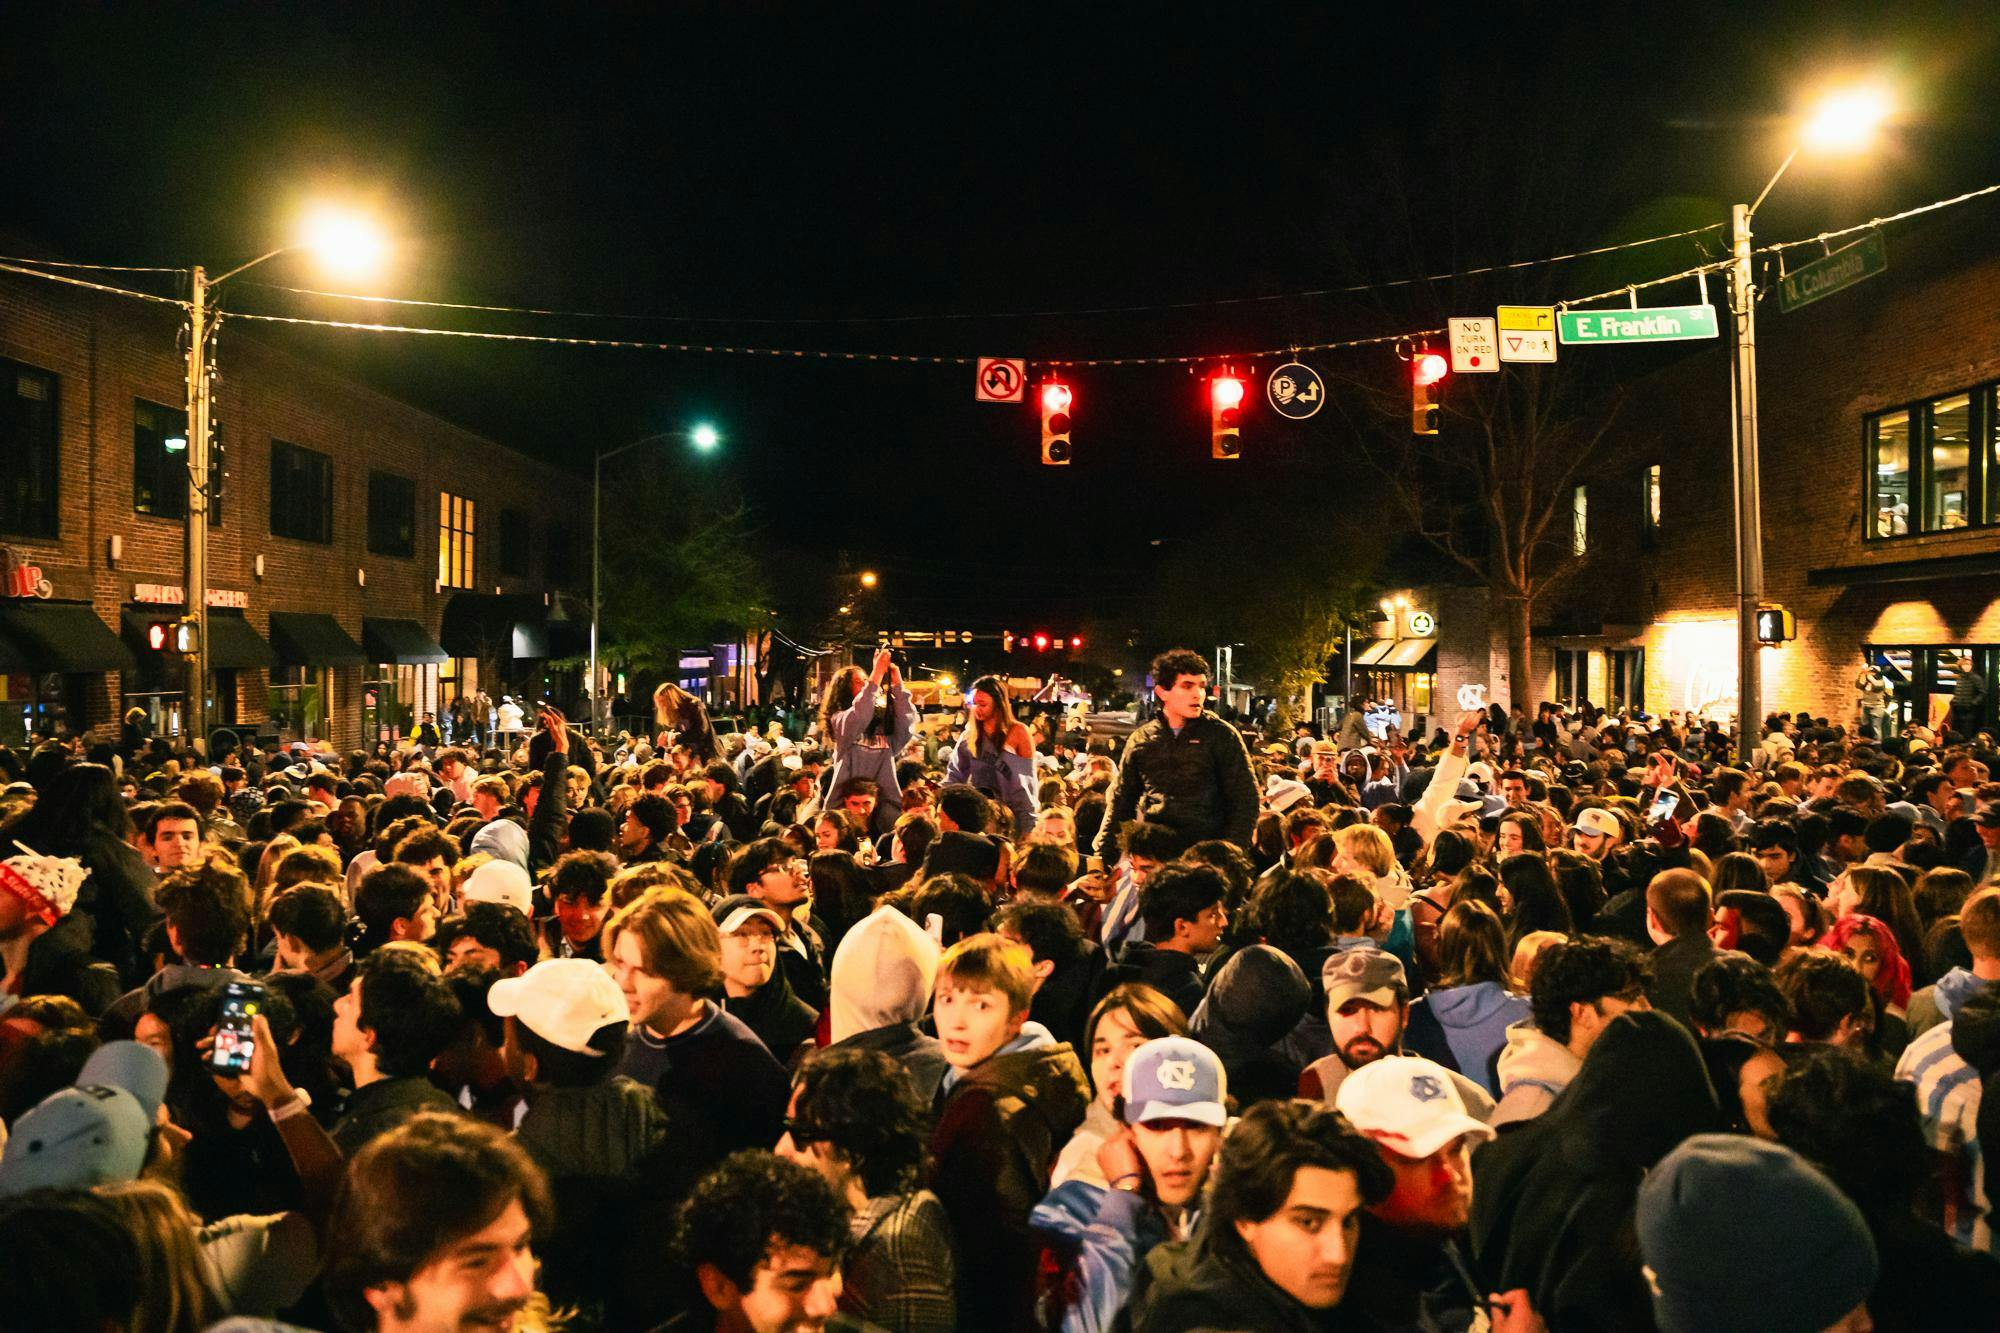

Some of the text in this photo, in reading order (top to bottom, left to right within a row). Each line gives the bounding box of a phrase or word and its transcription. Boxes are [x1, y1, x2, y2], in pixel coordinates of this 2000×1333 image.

[1802, 253, 1864, 295] Columbia
[1463, 322, 1481, 332] NO
[1576, 309, 1704, 338] E. Franklin St
[1461, 335, 1486, 343] TURN
[1456, 345, 1492, 354] ON RED
[1526, 341, 1536, 350] TO
[1280, 380, 1291, 395] P
